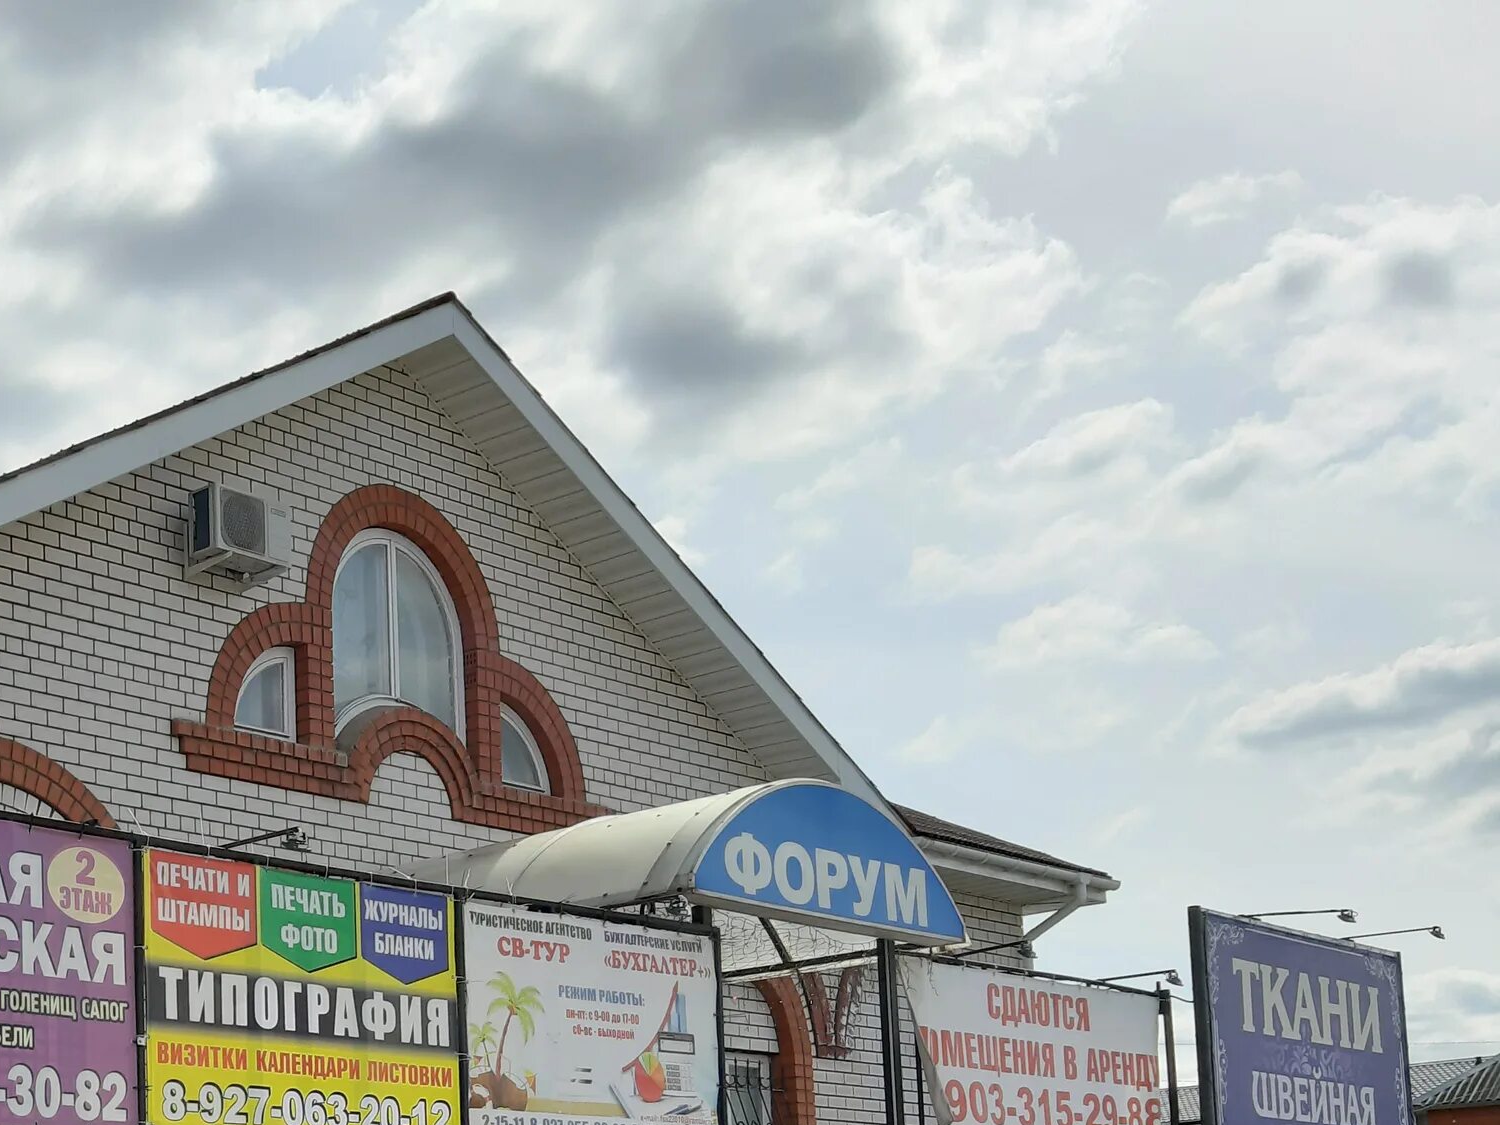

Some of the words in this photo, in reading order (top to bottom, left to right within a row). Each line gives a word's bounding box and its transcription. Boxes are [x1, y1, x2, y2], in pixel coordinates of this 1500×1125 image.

[74, 849, 96, 887] 2
[156, 861, 230, 895] ПЕЧАТИ
[237, 872, 251, 897] И
[723, 831, 929, 929] ФОРУМ
[59, 888, 113, 916] ЭТАЖ
[156, 897, 251, 933] ШТАМПЫ
[270, 882, 346, 919] ПЕЧАТЬ
[363, 898, 443, 931] ЖУРНАЛЫ
[280, 923, 339, 955] ФОТО
[468, 910, 544, 934] ТУРИСТИЧЕСКОЕ
[544, 921, 592, 941] АГЕНТСТВО
[603, 930, 670, 951] БУХГАЛТЕРСКИЕ
[670, 938, 703, 954] УСЛУГИ
[373, 931, 435, 961] БЛАНКИ
[496, 935, 571, 964] СВ-ТУР
[0, 989, 78, 1021] ГОЛЕНИЩ
[81, 997, 129, 1022] САПОГ
[157, 964, 451, 1048] ТИПОГРАФИЯ
[558, 984, 597, 1002] РЕЖИМ
[598, 989, 646, 1007] РАБОТЫ:
[986, 982, 1091, 1032] СДАЮТСЯ
[1231, 956, 1384, 1055] ТКАНИ
[156, 1040, 248, 1071] ВИЗИТКИ
[255, 1049, 361, 1081] КАЛЕНДАРИ
[366, 1060, 453, 1088] ЛИСТОВКИ
[1063, 1045, 1078, 1081] В
